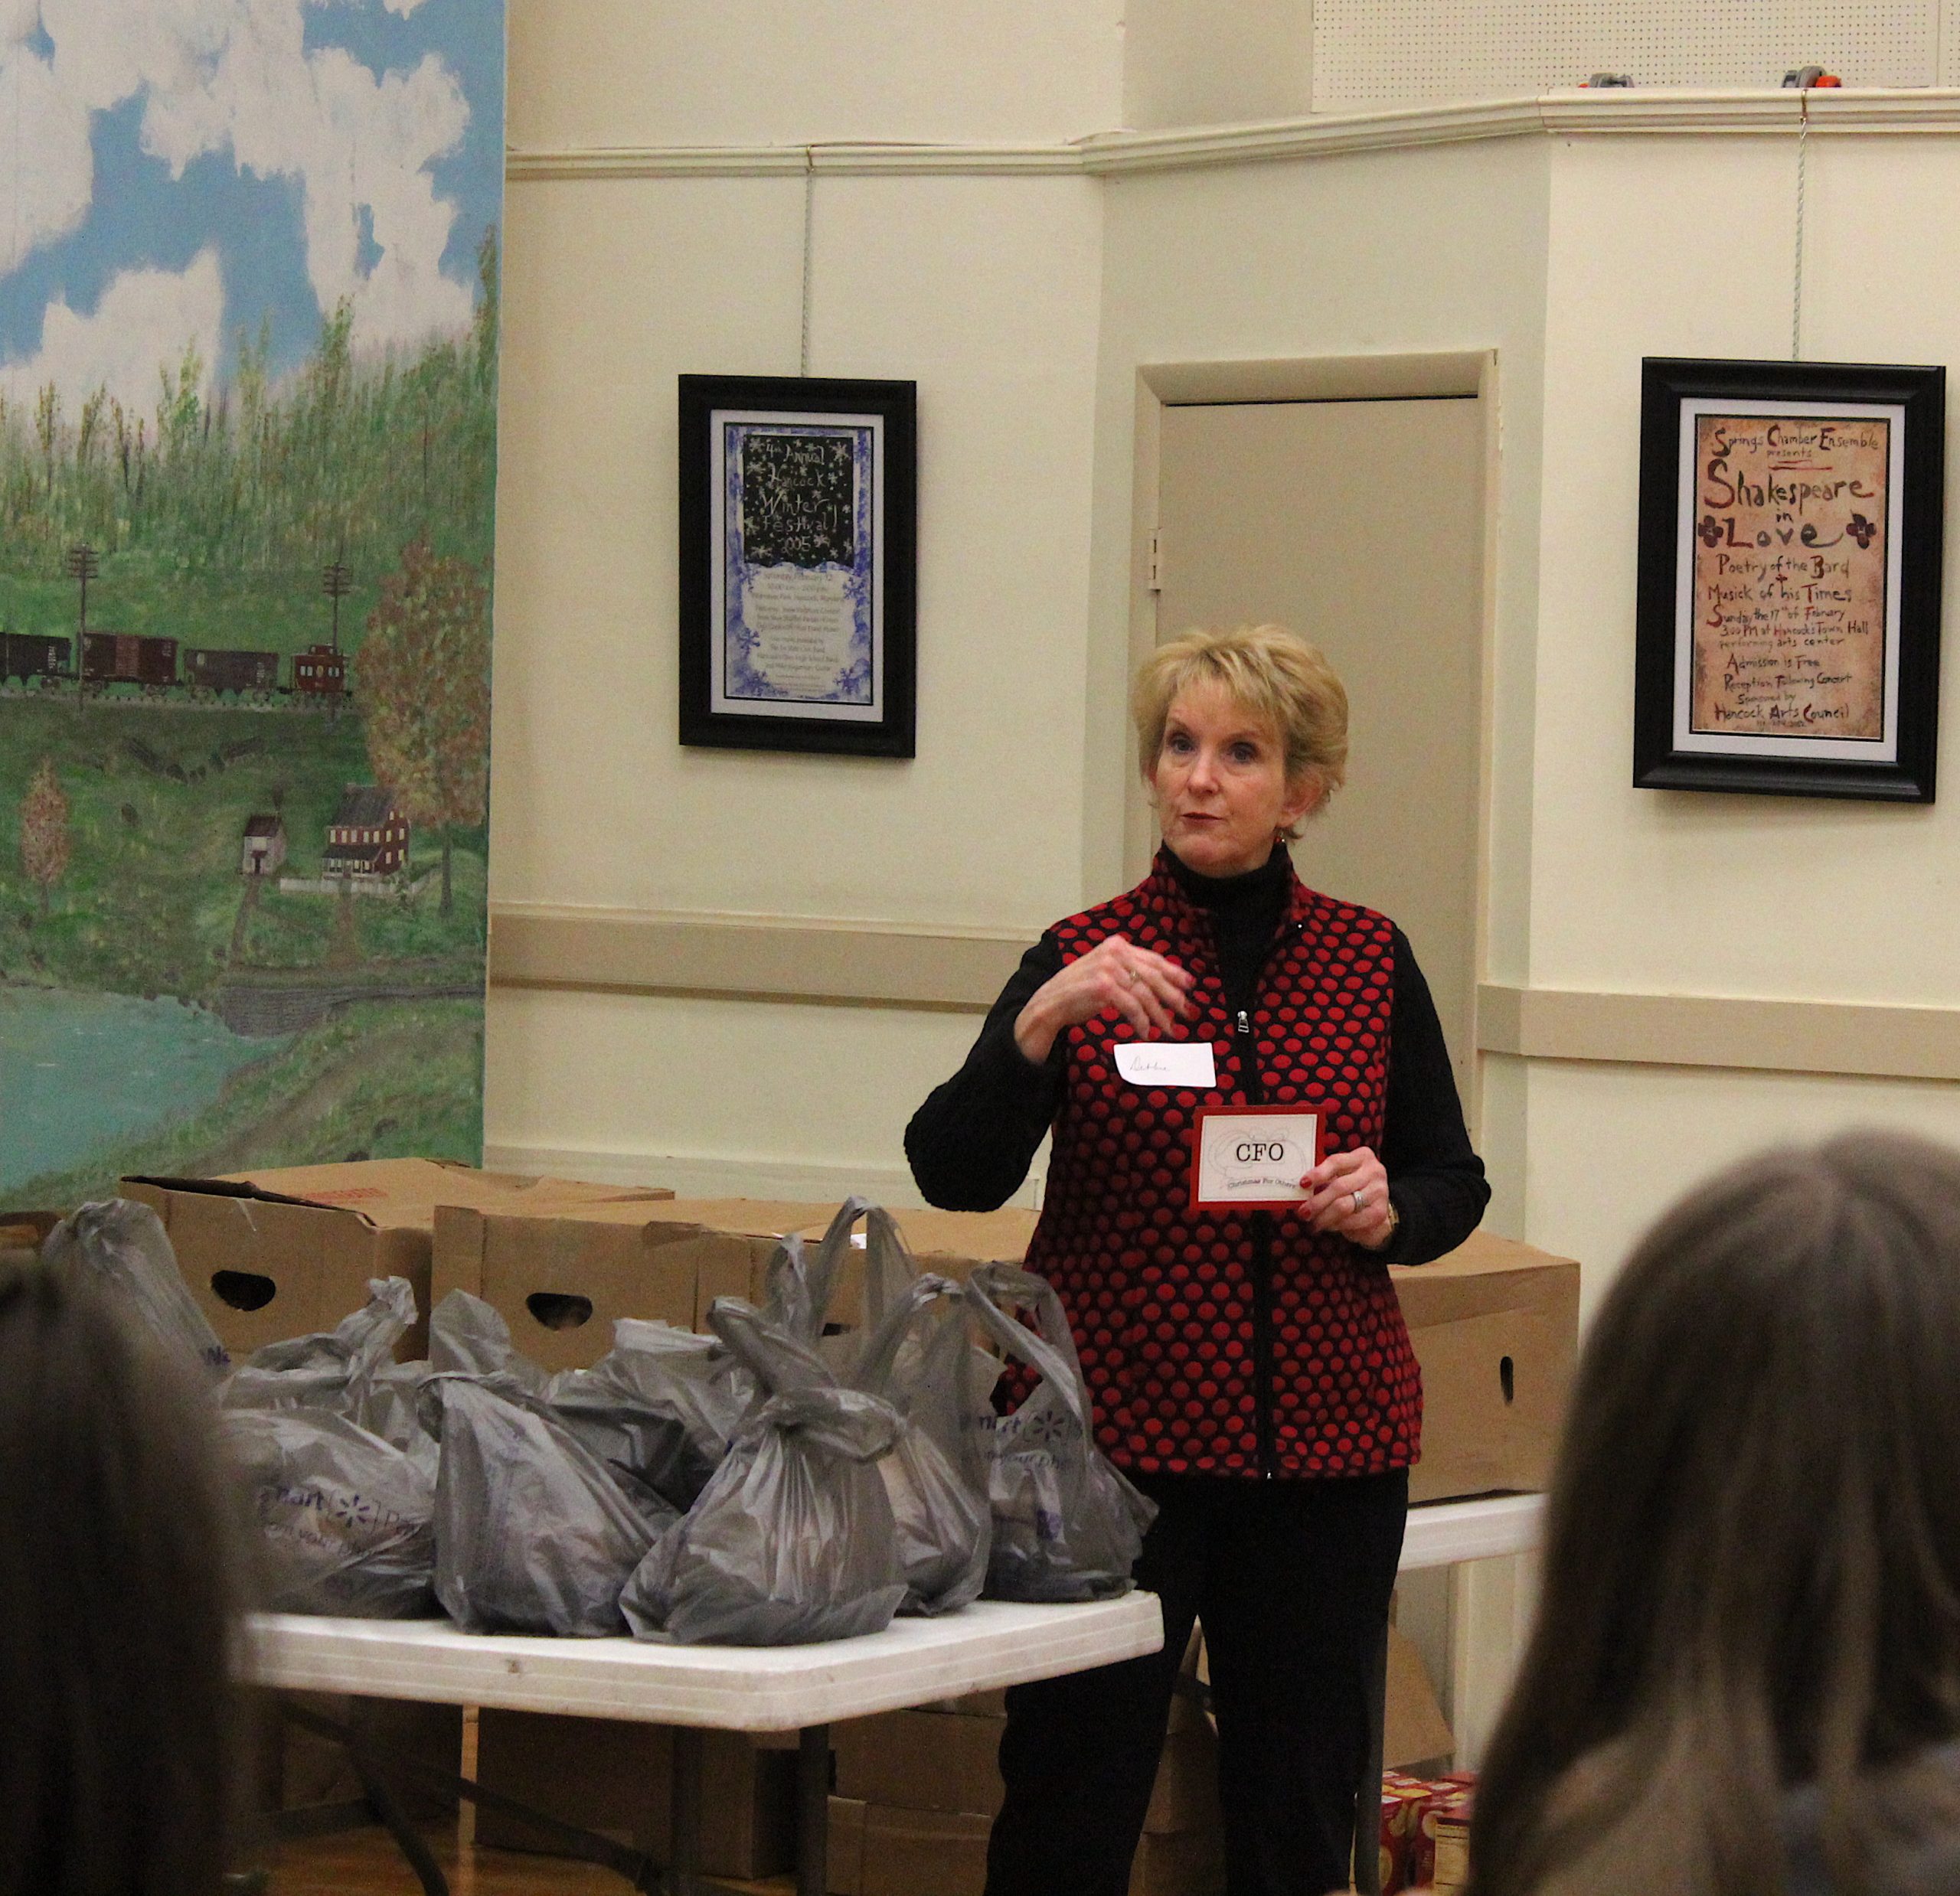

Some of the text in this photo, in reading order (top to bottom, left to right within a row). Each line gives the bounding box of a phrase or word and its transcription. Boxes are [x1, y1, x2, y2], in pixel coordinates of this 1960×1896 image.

[1712, 424, 1879, 457] Springs Chamber Ensemble
[783, 444, 825, 465] Annual
[1767, 450, 1811, 458] presents
[767, 462, 827, 488] Hancock
[1704, 458, 1874, 516] Shakespeare
[760, 488, 830, 517] Winter
[1775, 508, 1794, 524] in
[1722, 517, 1844, 548] Love
[775, 536, 812, 556] 2005
[1716, 553, 1851, 582] Poetry of the Bard
[1708, 582, 1852, 603] Musick of his Times
[1707, 604, 1752, 627] Sunday
[1753, 608, 1769, 620] the
[1788, 606, 1799, 619] of
[1761, 624, 1770, 635] at
[1815, 622, 1843, 635] Town
[1847, 620, 1868, 635] Hall
[1777, 637, 1796, 647] arts
[1804, 636, 1844, 645] center
[1726, 653, 1777, 674] Admission
[1795, 654, 1820, 669] Free
[1714, 702, 1849, 723] Hancock Arts Council
[1236, 1143, 1284, 1162] CFO
[1228, 1178, 1261, 1189] Christmas
